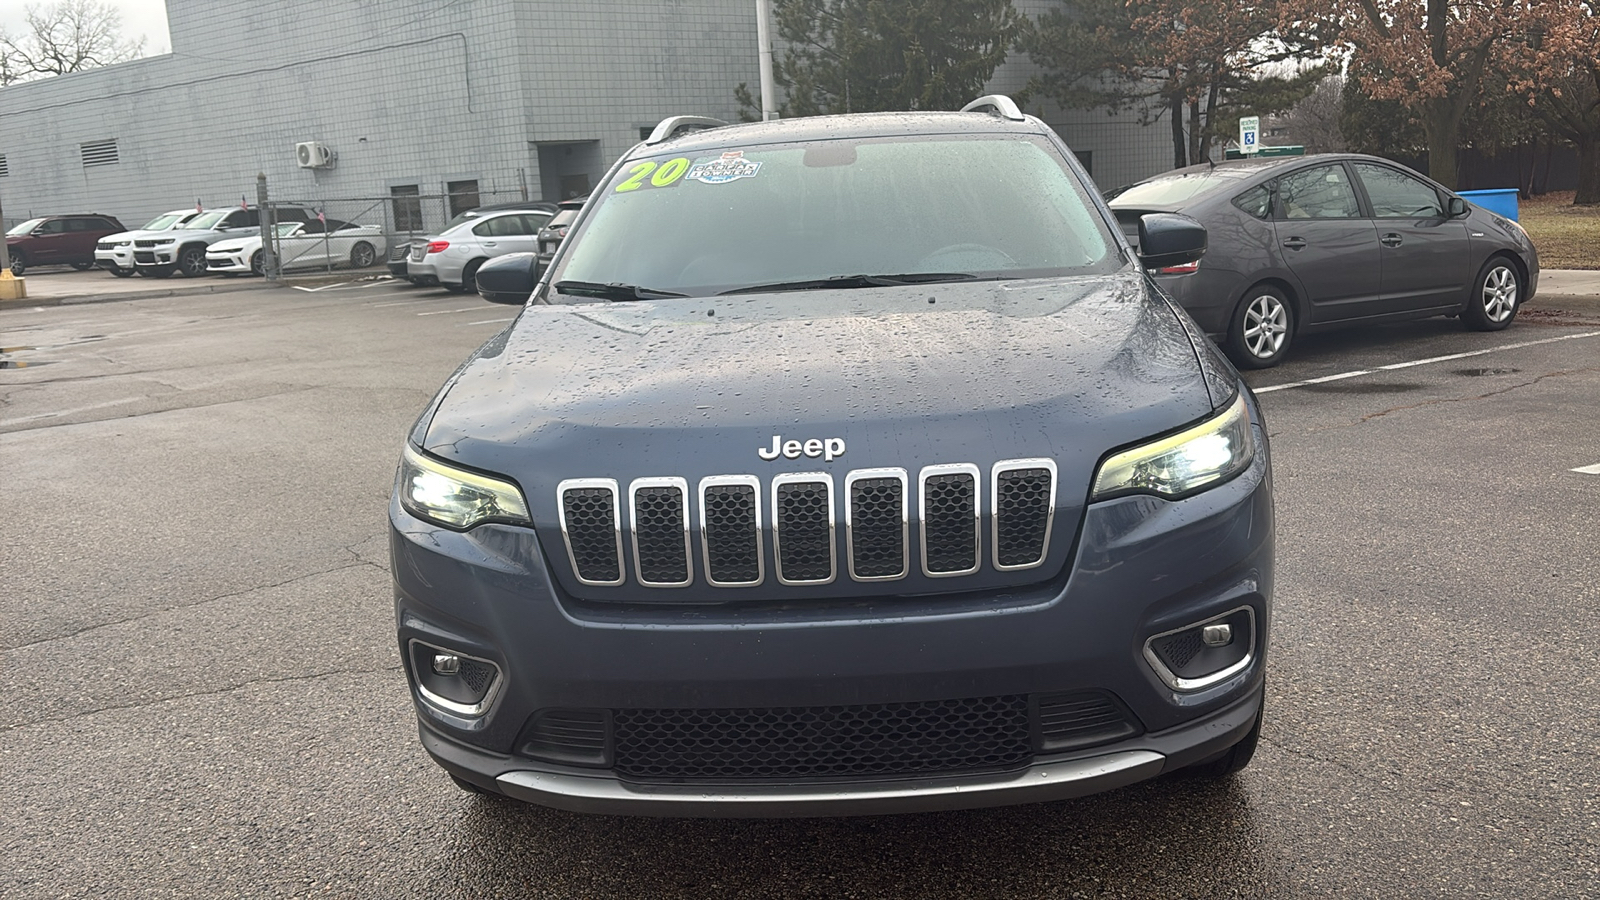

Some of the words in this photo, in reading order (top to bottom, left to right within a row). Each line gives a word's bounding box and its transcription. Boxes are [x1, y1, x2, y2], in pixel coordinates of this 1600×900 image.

[615, 157, 690, 193] 20
[695, 163, 756, 172] CARFAX
[758, 434, 846, 462] Jeep
